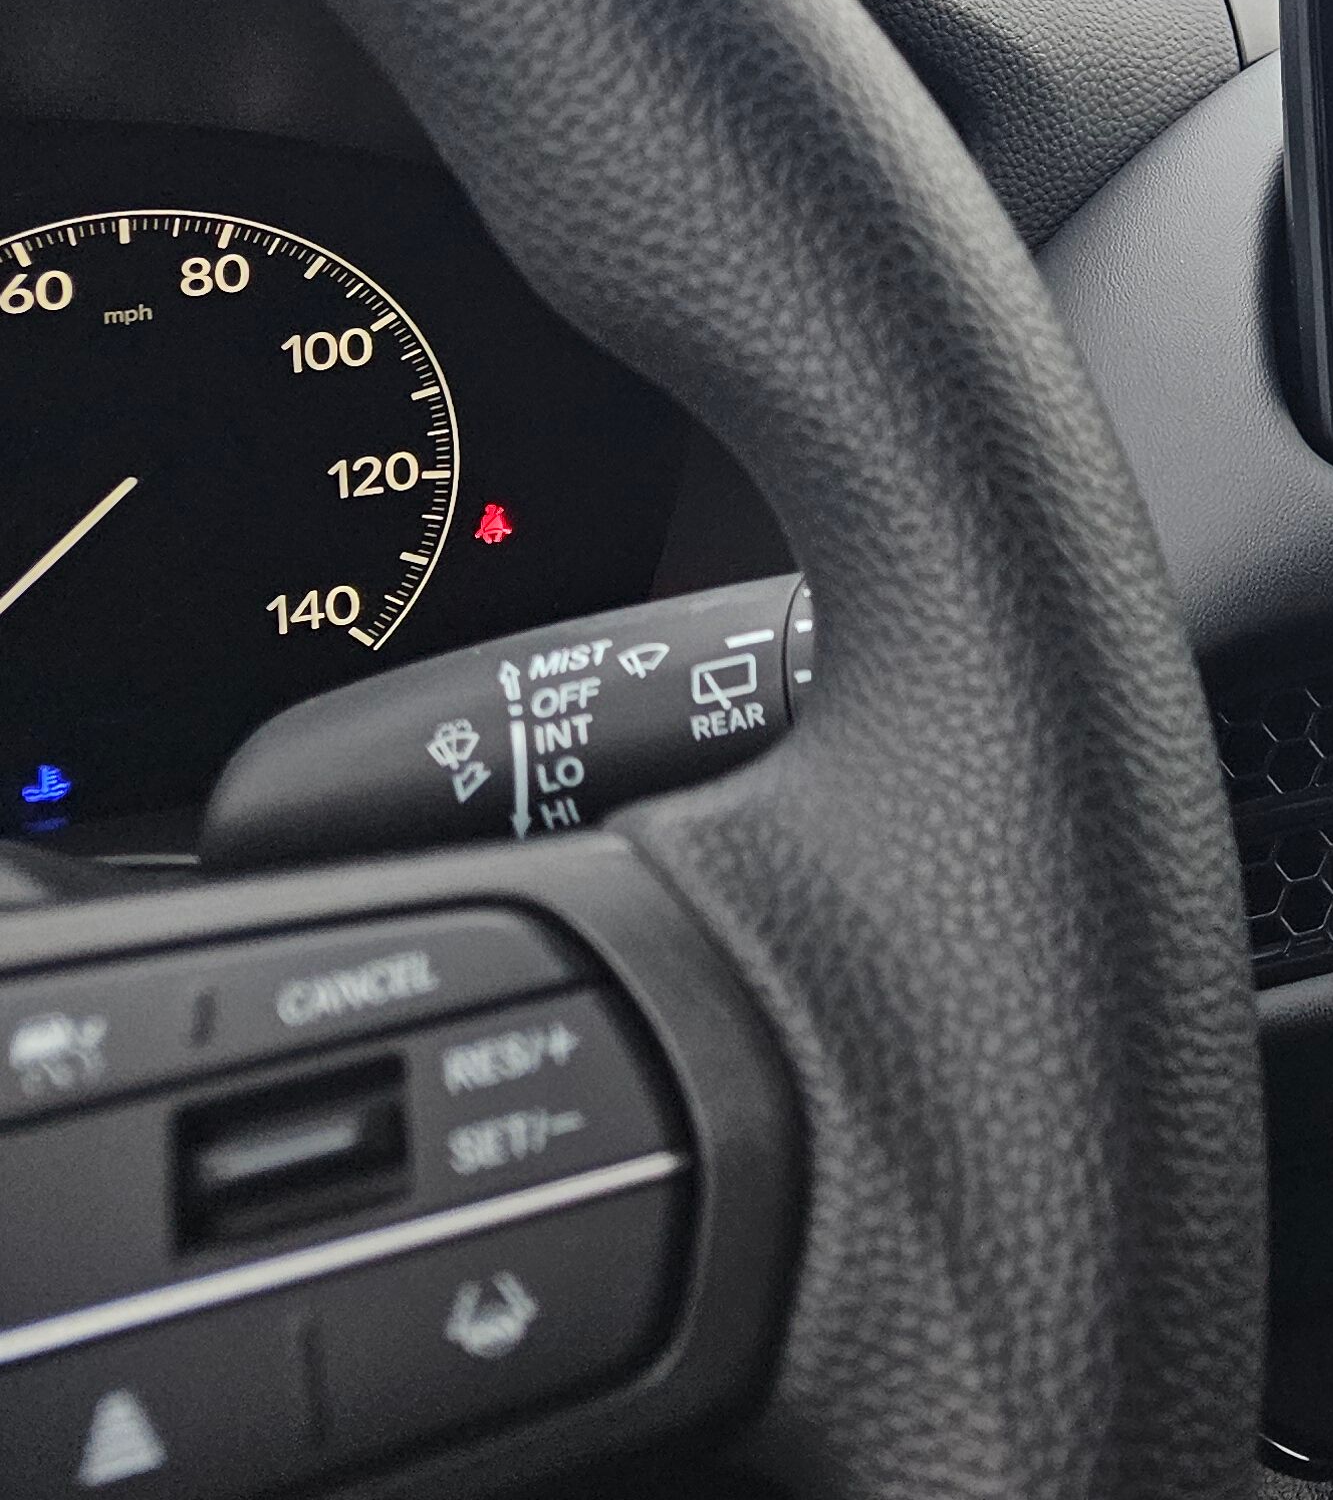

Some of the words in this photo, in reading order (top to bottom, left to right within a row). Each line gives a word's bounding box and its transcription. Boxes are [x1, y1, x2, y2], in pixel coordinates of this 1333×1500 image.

[0, 269, 74, 315] 60
[180, 253, 251, 297] 80
[103, 304, 154, 328] mph
[280, 326, 374, 374] 100
[328, 450, 420, 500] 120
[265, 584, 362, 635] 140
[529, 640, 612, 681] MIST
[531, 676, 602, 717] OFF
[534, 713, 593, 754] INT
[690, 703, 766, 742] REAR
[536, 758, 586, 793] LO
[541, 797, 581, 830] HI
[277, 949, 439, 1028] CANCEL
